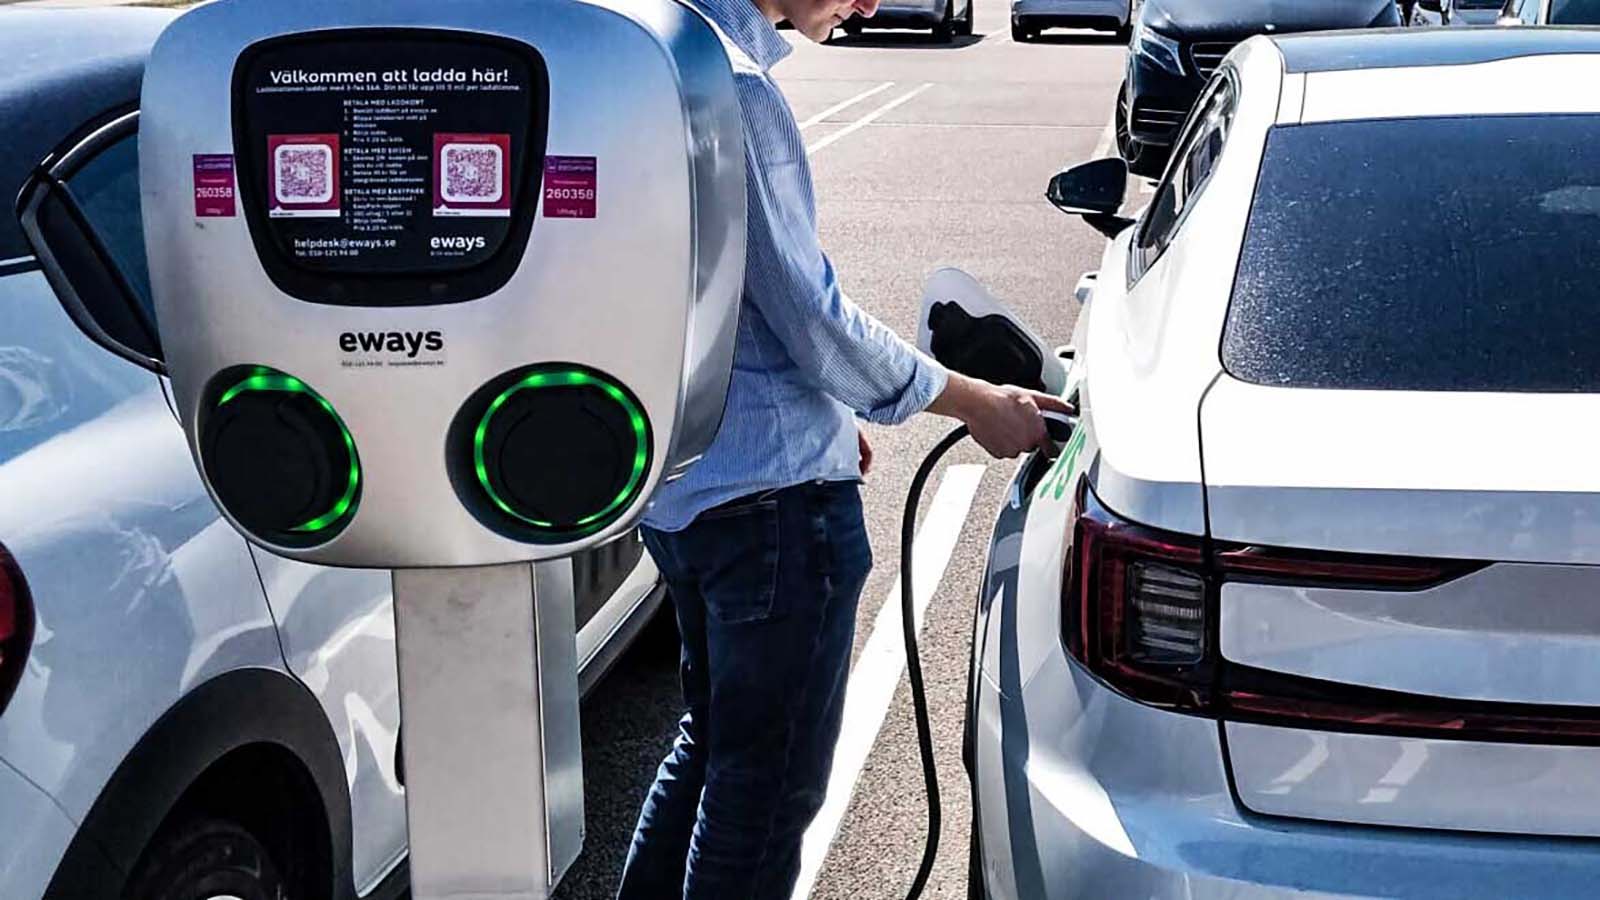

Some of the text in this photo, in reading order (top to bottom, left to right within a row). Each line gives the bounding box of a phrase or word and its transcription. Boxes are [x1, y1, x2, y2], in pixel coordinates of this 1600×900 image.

[270, 68, 508, 84] Välkommen att ladda här!
[546, 188, 594, 200] 260358
[294, 238, 396, 249] helpdesk@eways.se
[430, 236, 485, 251] eways
[339, 331, 443, 358] eways
